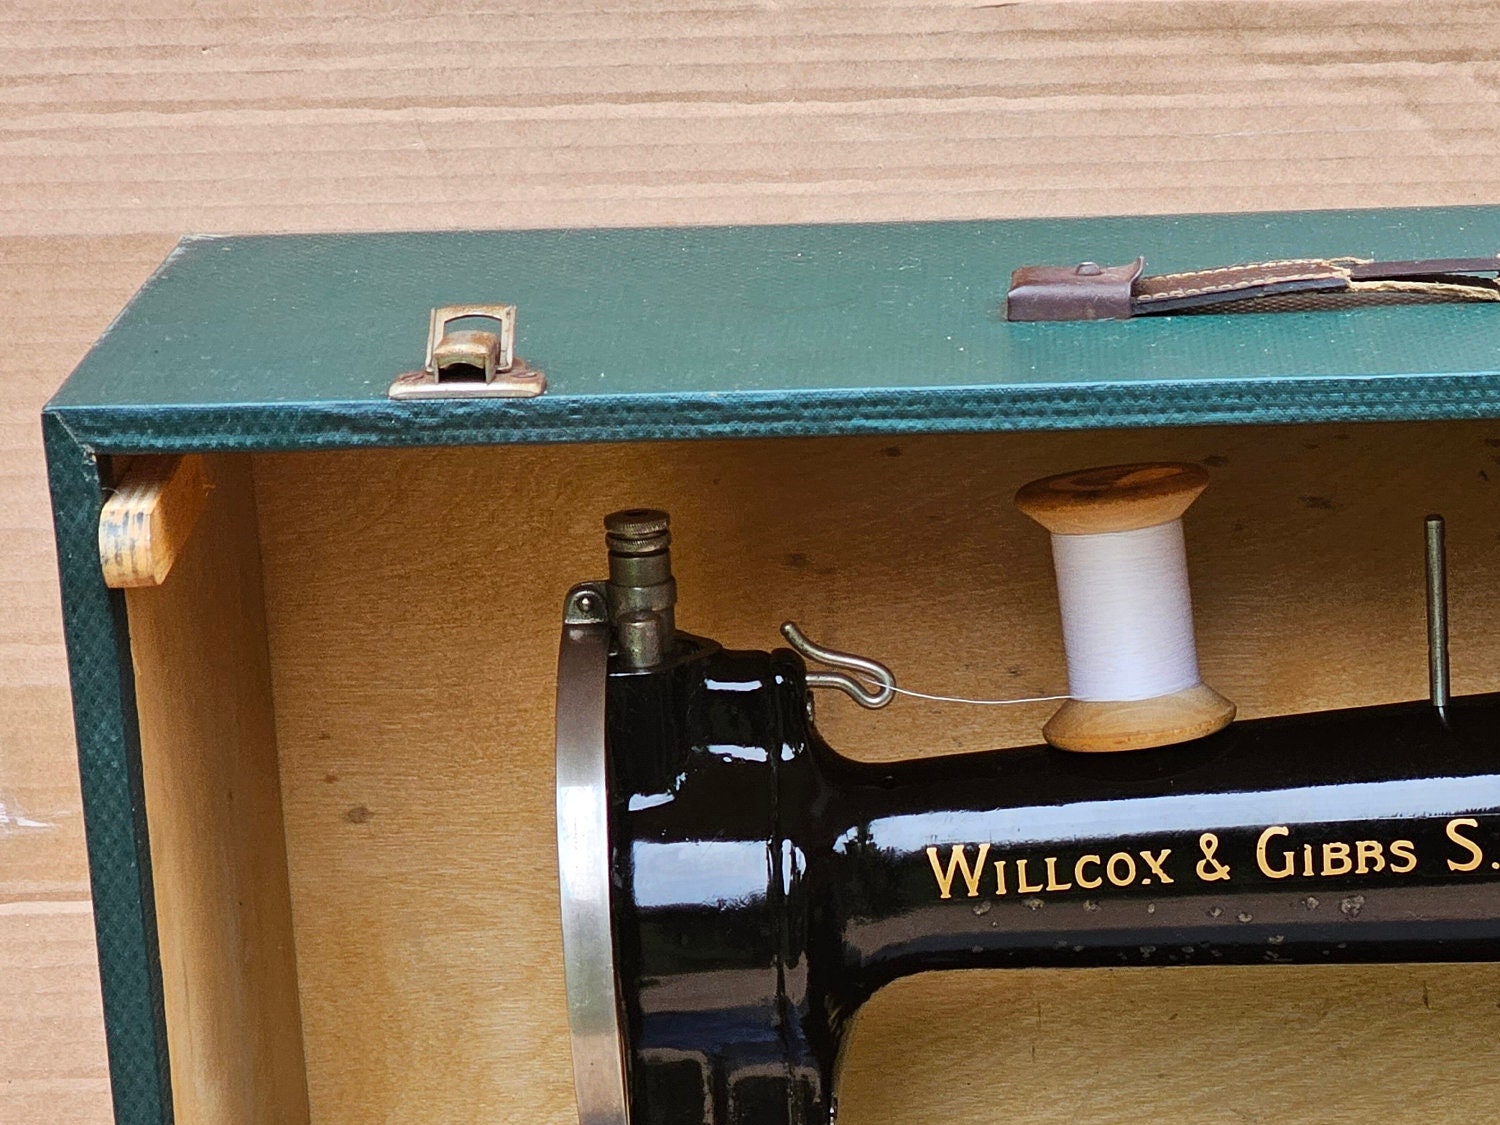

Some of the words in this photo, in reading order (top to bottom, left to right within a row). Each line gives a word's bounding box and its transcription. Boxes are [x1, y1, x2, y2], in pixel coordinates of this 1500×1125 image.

[928, 843, 1173, 899] WILLCOX
[1196, 833, 1231, 882] &
[1256, 827, 1419, 880] GIBBS
